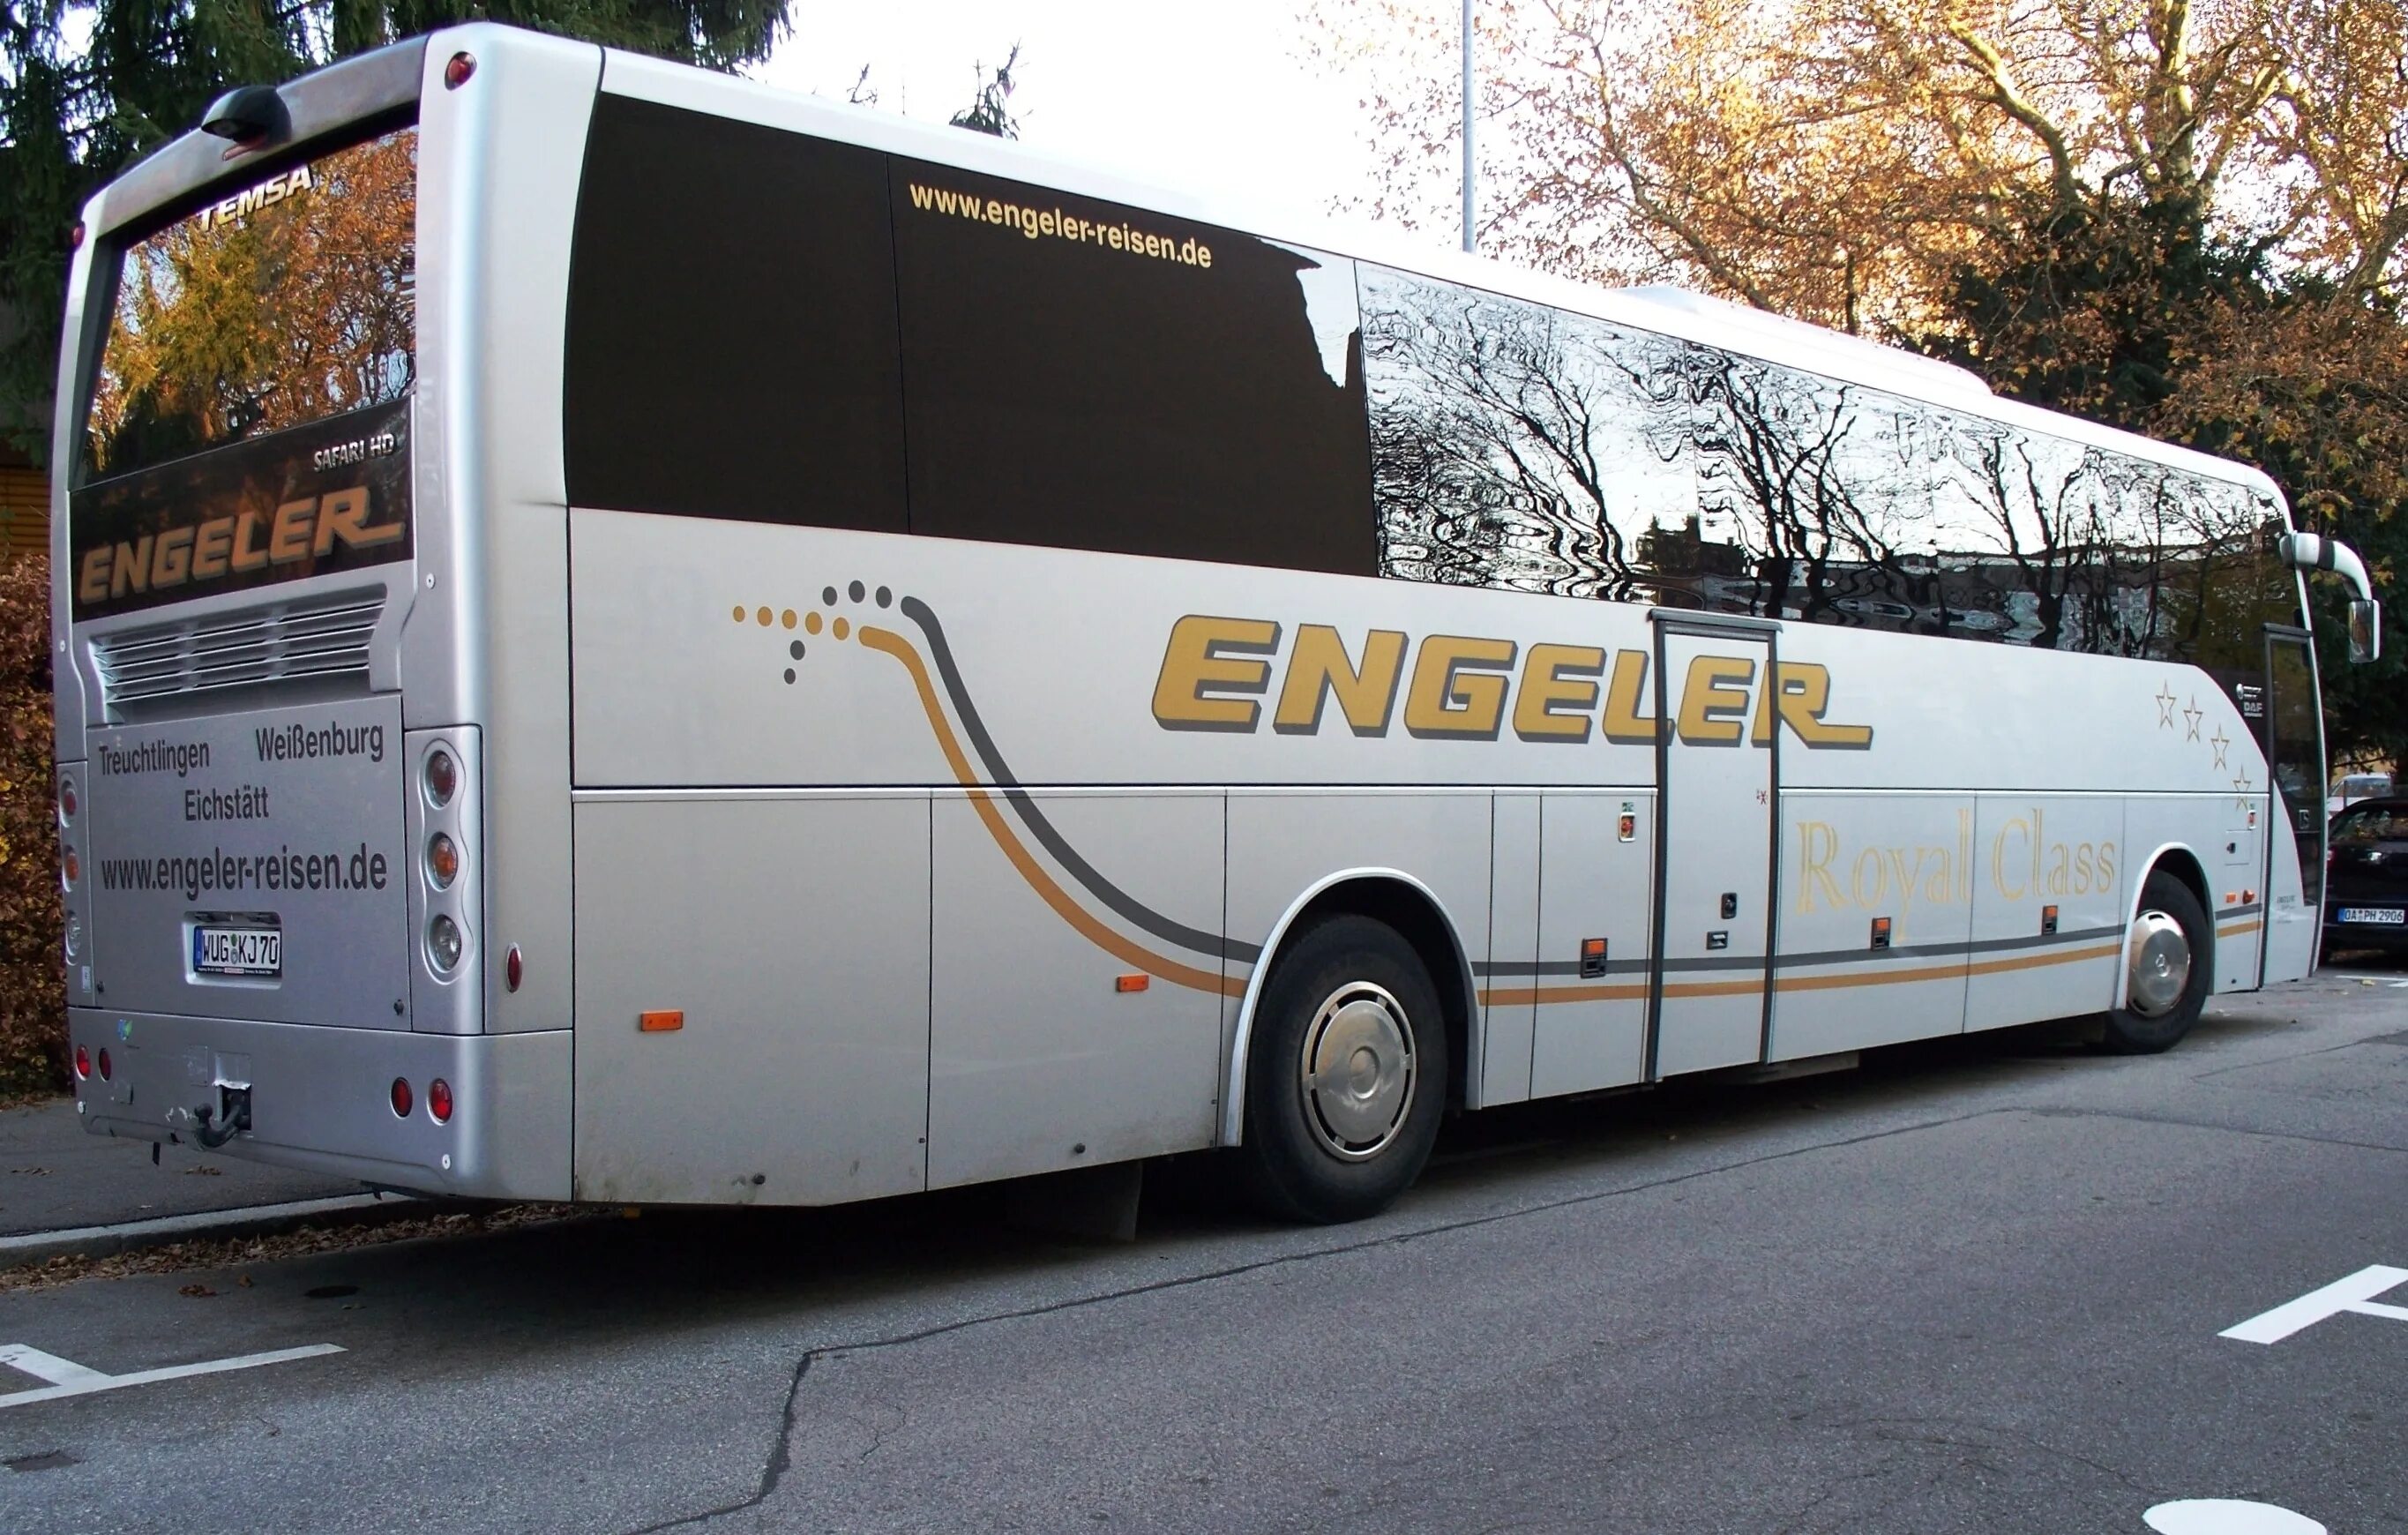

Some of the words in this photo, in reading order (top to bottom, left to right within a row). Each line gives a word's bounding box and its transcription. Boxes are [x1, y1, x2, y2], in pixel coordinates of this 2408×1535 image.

[196, 164, 312, 232] TEMSA
[909, 183, 1212, 268] www.engeler-reisen.de
[314, 439, 365, 473] SAFARI
[370, 433, 395, 457] HD
[79, 485, 406, 606] ENGELER
[1151, 613, 1873, 751] ENGELER
[99, 739, 211, 778] Treuchtlingen
[256, 721, 385, 763] Weißenburg
[184, 784, 270, 822] Eichstätt
[101, 842, 388, 902] www.engeler-reisen.de
[1794, 806, 1972, 946] Royal
[1991, 806, 2116, 902] Class
[203, 934, 229, 963] WUG
